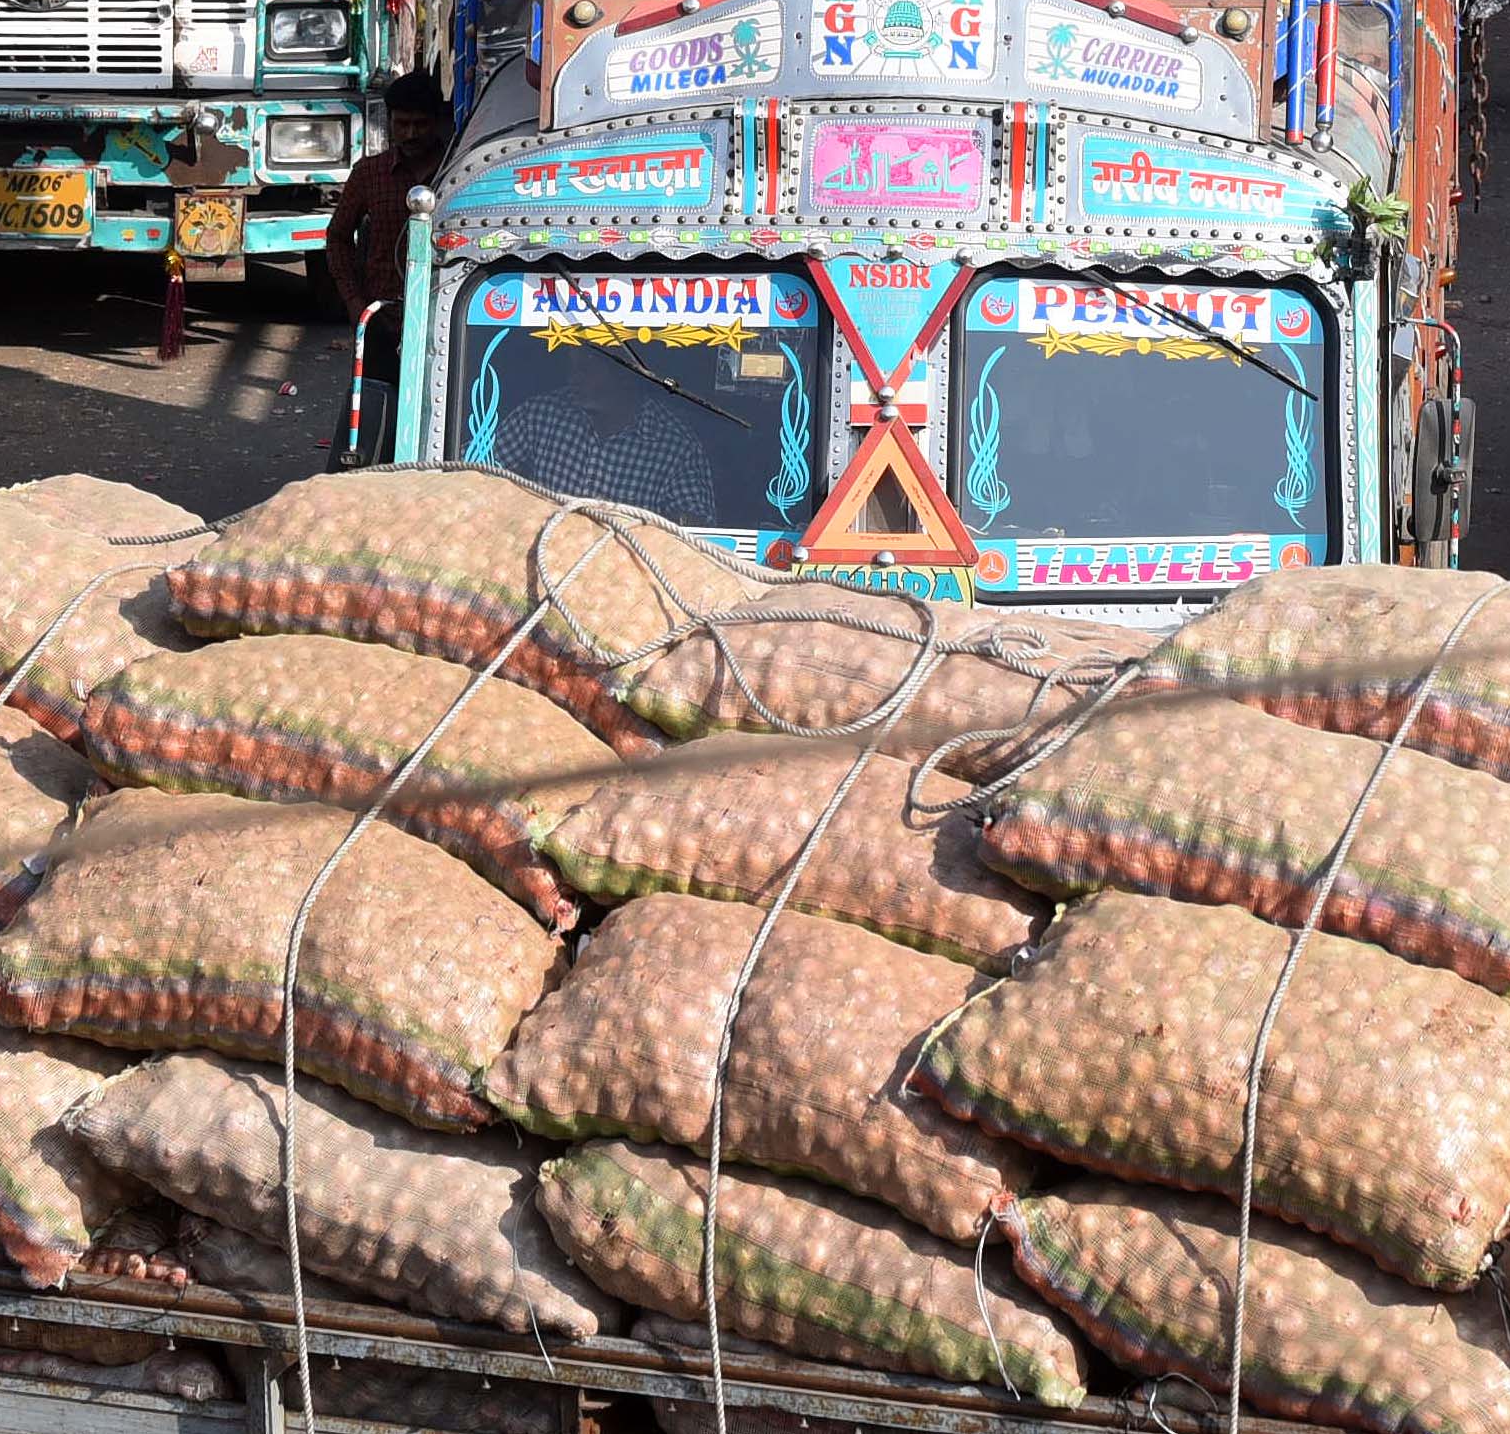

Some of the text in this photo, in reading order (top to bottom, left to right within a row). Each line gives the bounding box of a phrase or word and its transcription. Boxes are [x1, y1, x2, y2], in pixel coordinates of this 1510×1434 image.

[628, 32, 725, 74] GOODS
[1081, 37, 1184, 79] CARRIER
[630, 63, 728, 94] MILEGA
[1080, 67, 1181, 99] MUQADDAR
[513, 163, 562, 198] या
[1091, 150, 1182, 206] गरीब
[532, 276, 762, 315] ALL INDIA
[1032, 285, 1267, 331] PERMIT
[1031, 543, 1255, 584] TRAVELS
